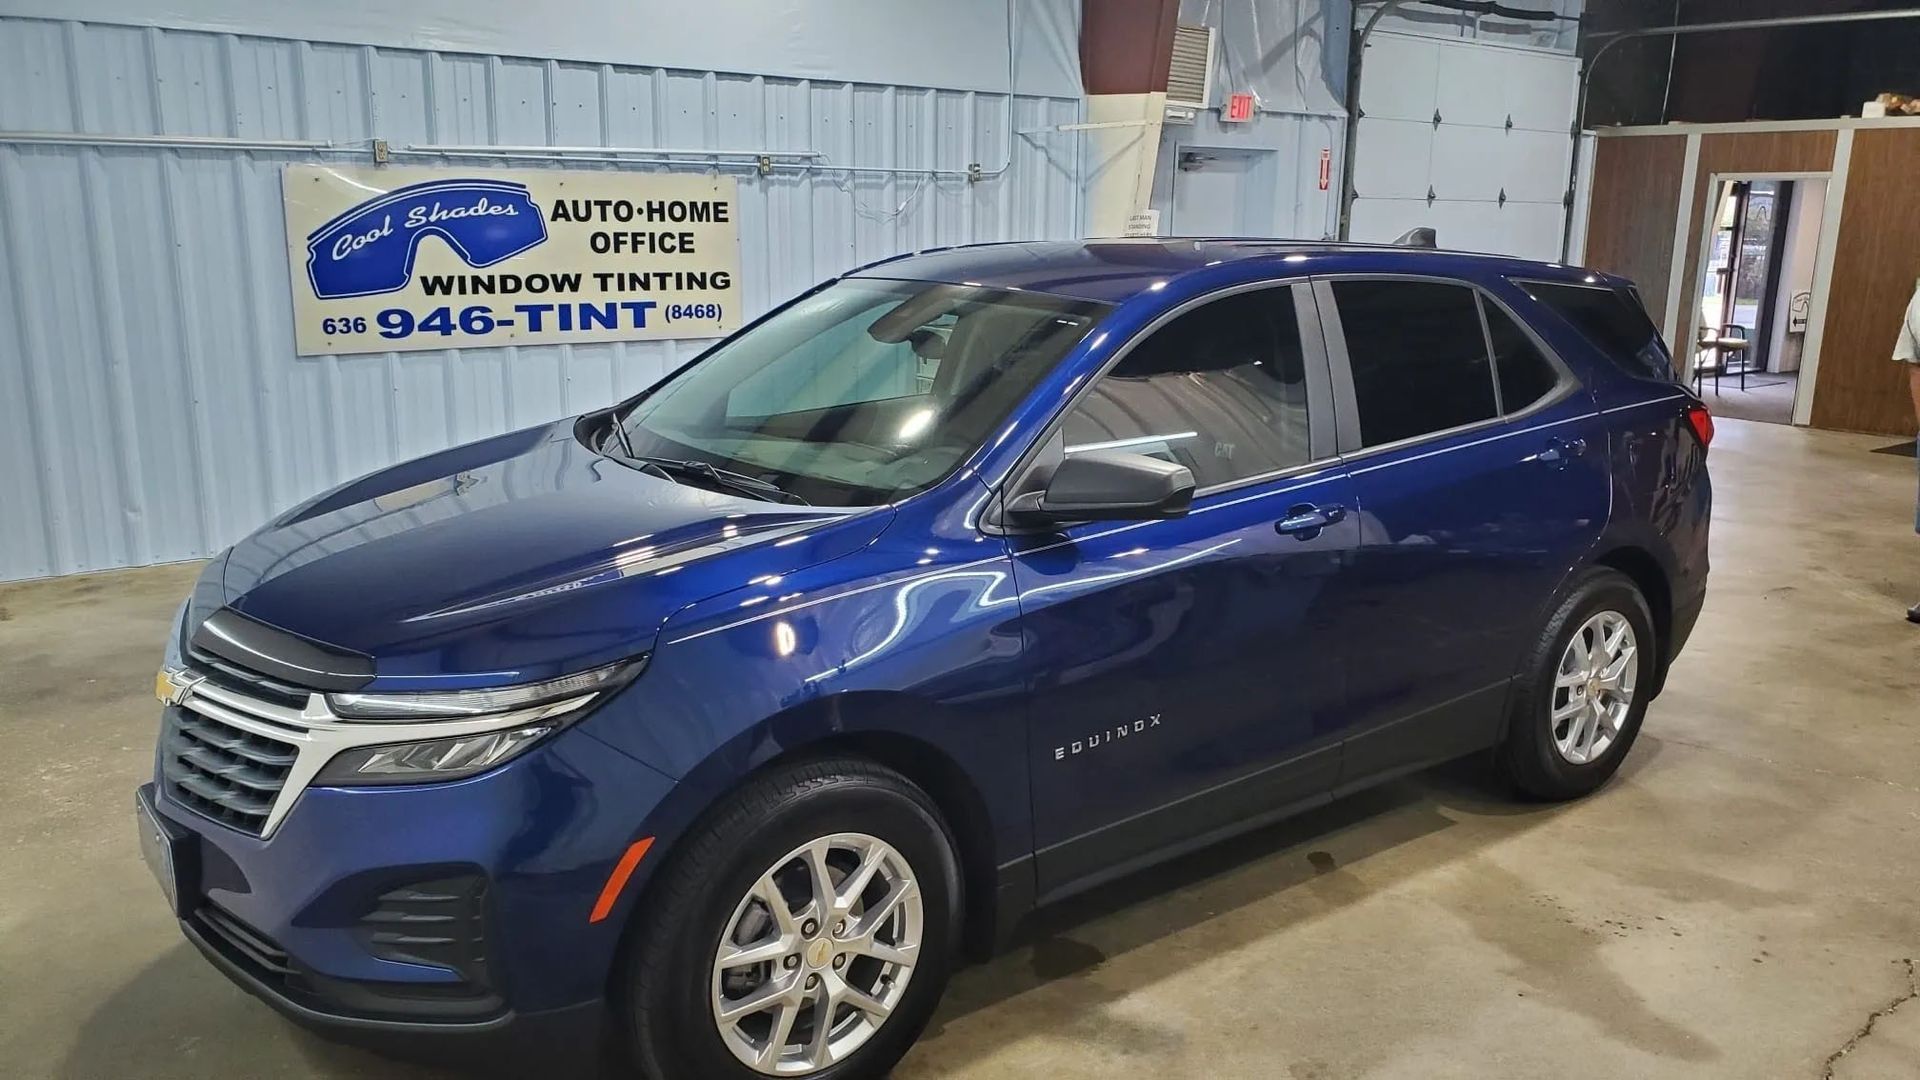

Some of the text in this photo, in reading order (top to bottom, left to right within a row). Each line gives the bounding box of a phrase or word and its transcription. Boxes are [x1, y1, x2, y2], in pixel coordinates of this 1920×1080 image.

[1231, 94, 1252, 119] EXIT
[331, 197, 519, 261] Cool Shades
[590, 231, 696, 254] OFFICE
[420, 271, 732, 296] WINDOW TINTING
[322, 301, 723, 340] 636 946-TINT (8468)
[1054, 713, 1161, 760] EQUINOX
